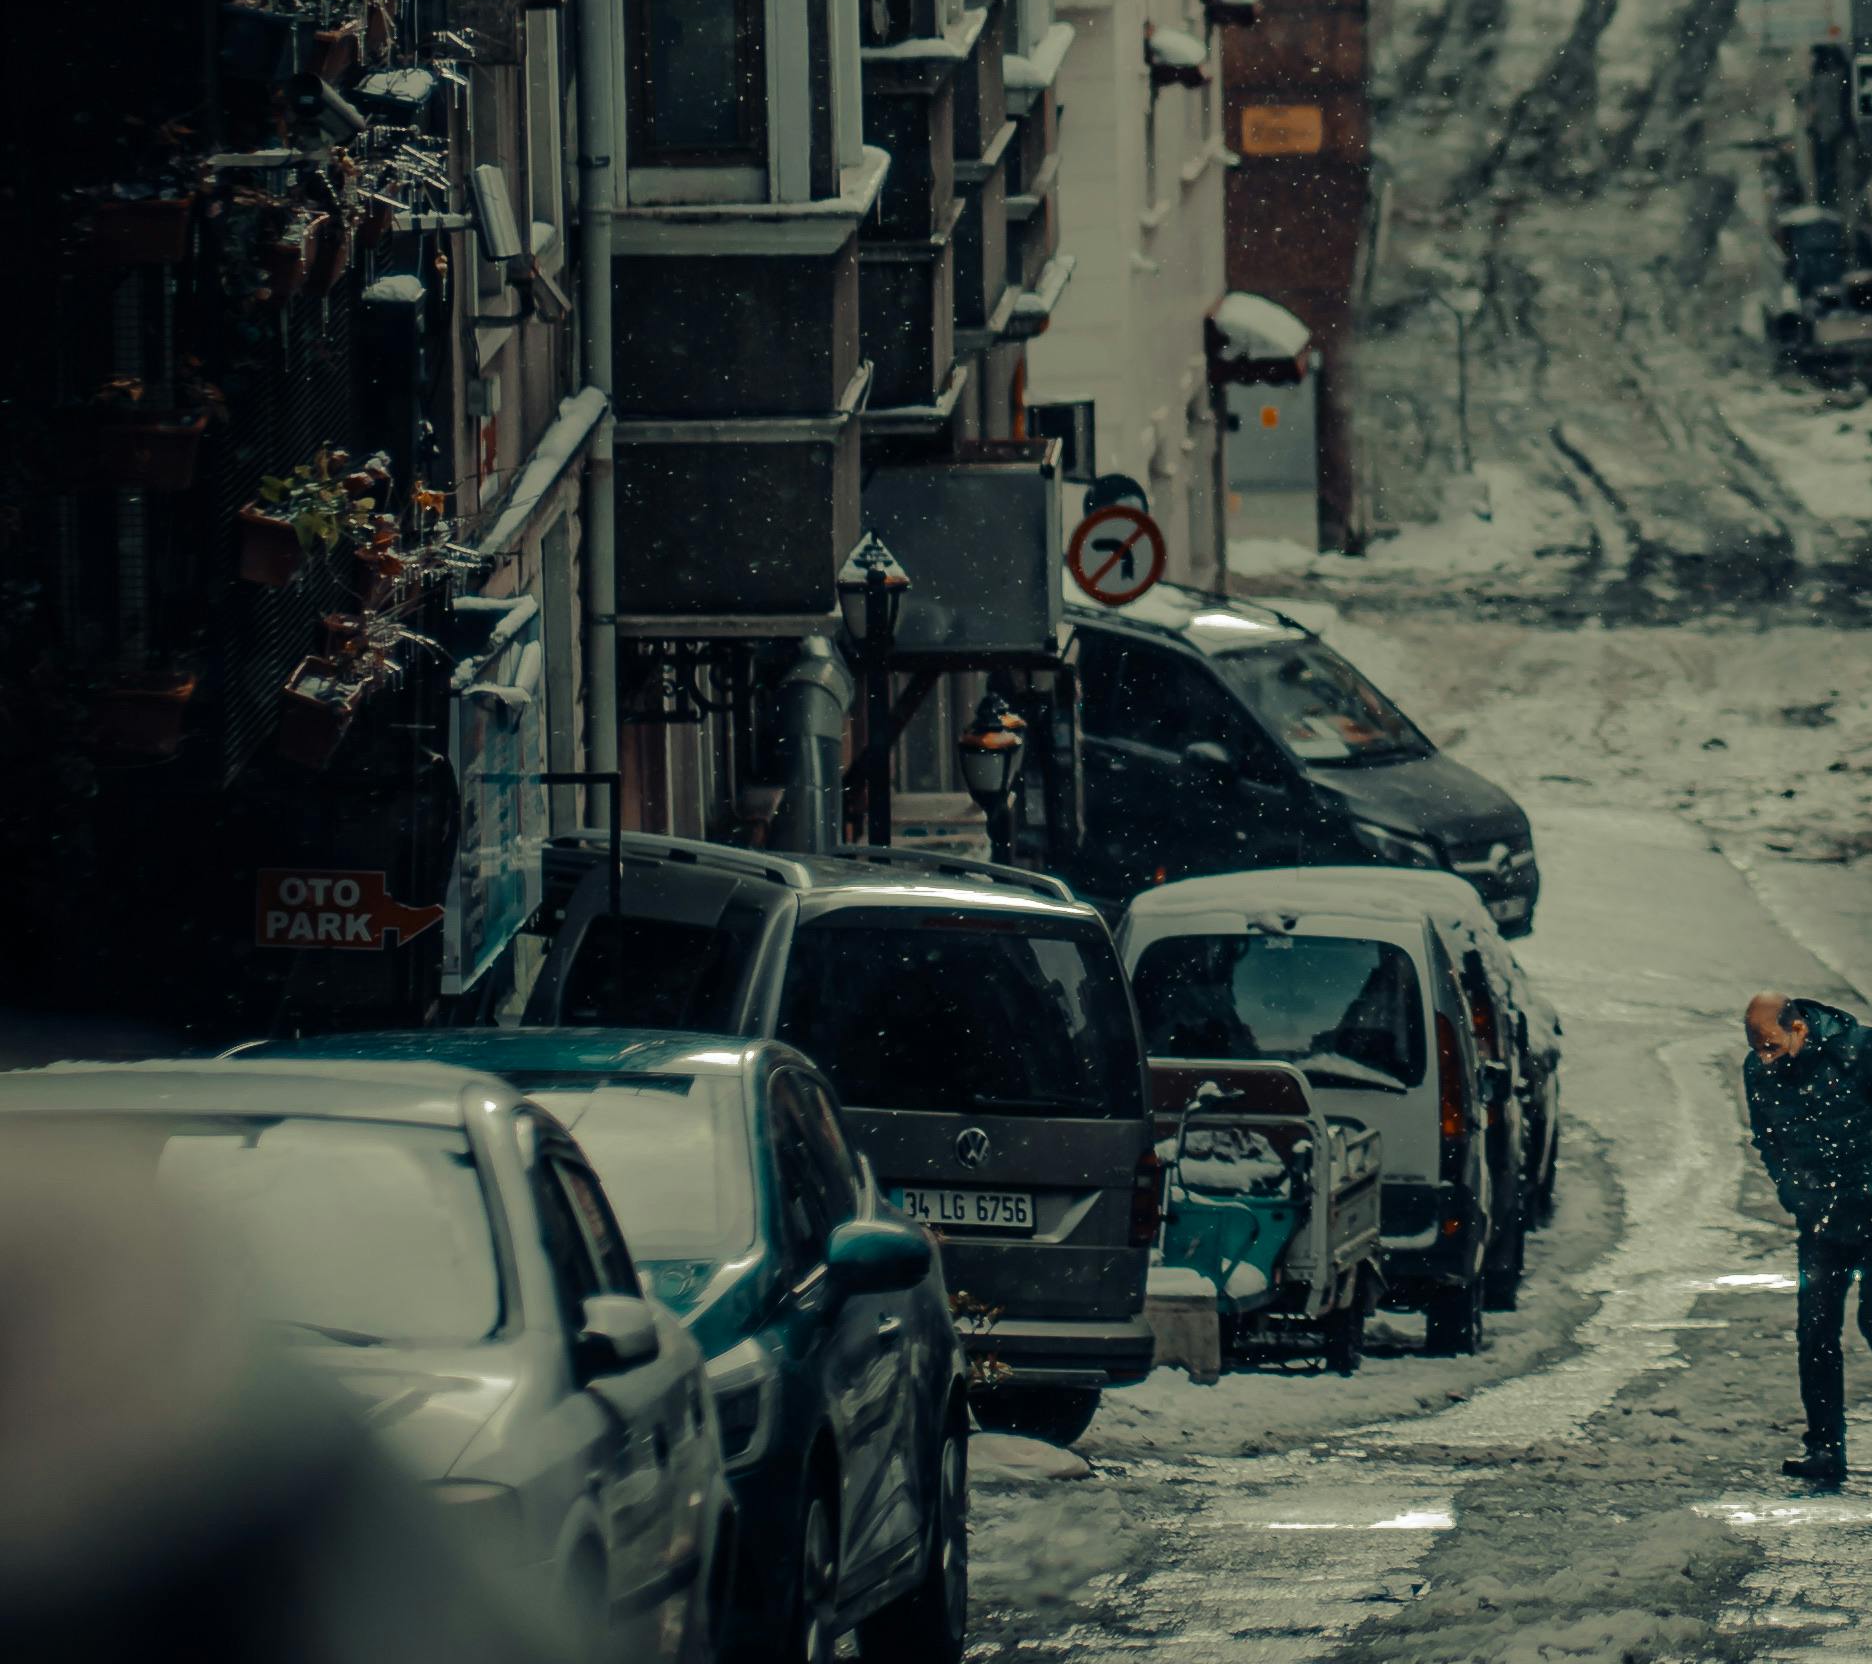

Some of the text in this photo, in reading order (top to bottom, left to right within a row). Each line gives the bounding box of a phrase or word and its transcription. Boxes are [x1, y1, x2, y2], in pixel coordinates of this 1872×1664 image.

[277, 876, 361, 908] OTO
[265, 910, 373, 942] PARK
[905, 1192, 1026, 1223] 34 LG 6756
